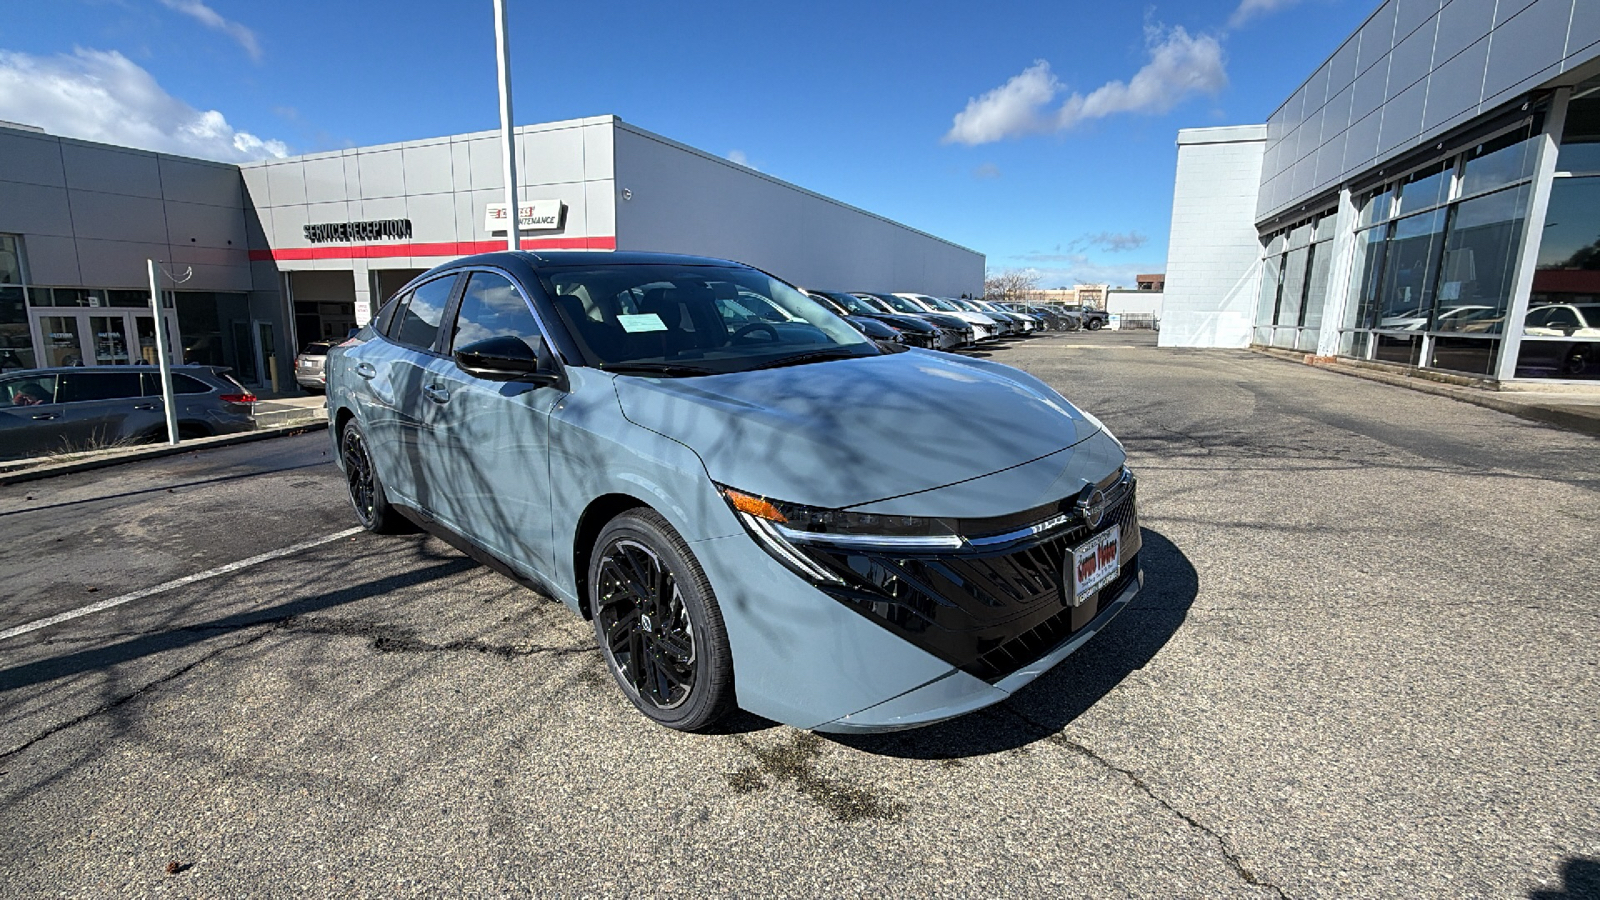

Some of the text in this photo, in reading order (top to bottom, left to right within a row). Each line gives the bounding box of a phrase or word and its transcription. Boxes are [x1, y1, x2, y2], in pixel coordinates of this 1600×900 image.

[518, 216, 555, 226] NTENANCE
[303, 219, 407, 240] SERVICE RECEPTION
